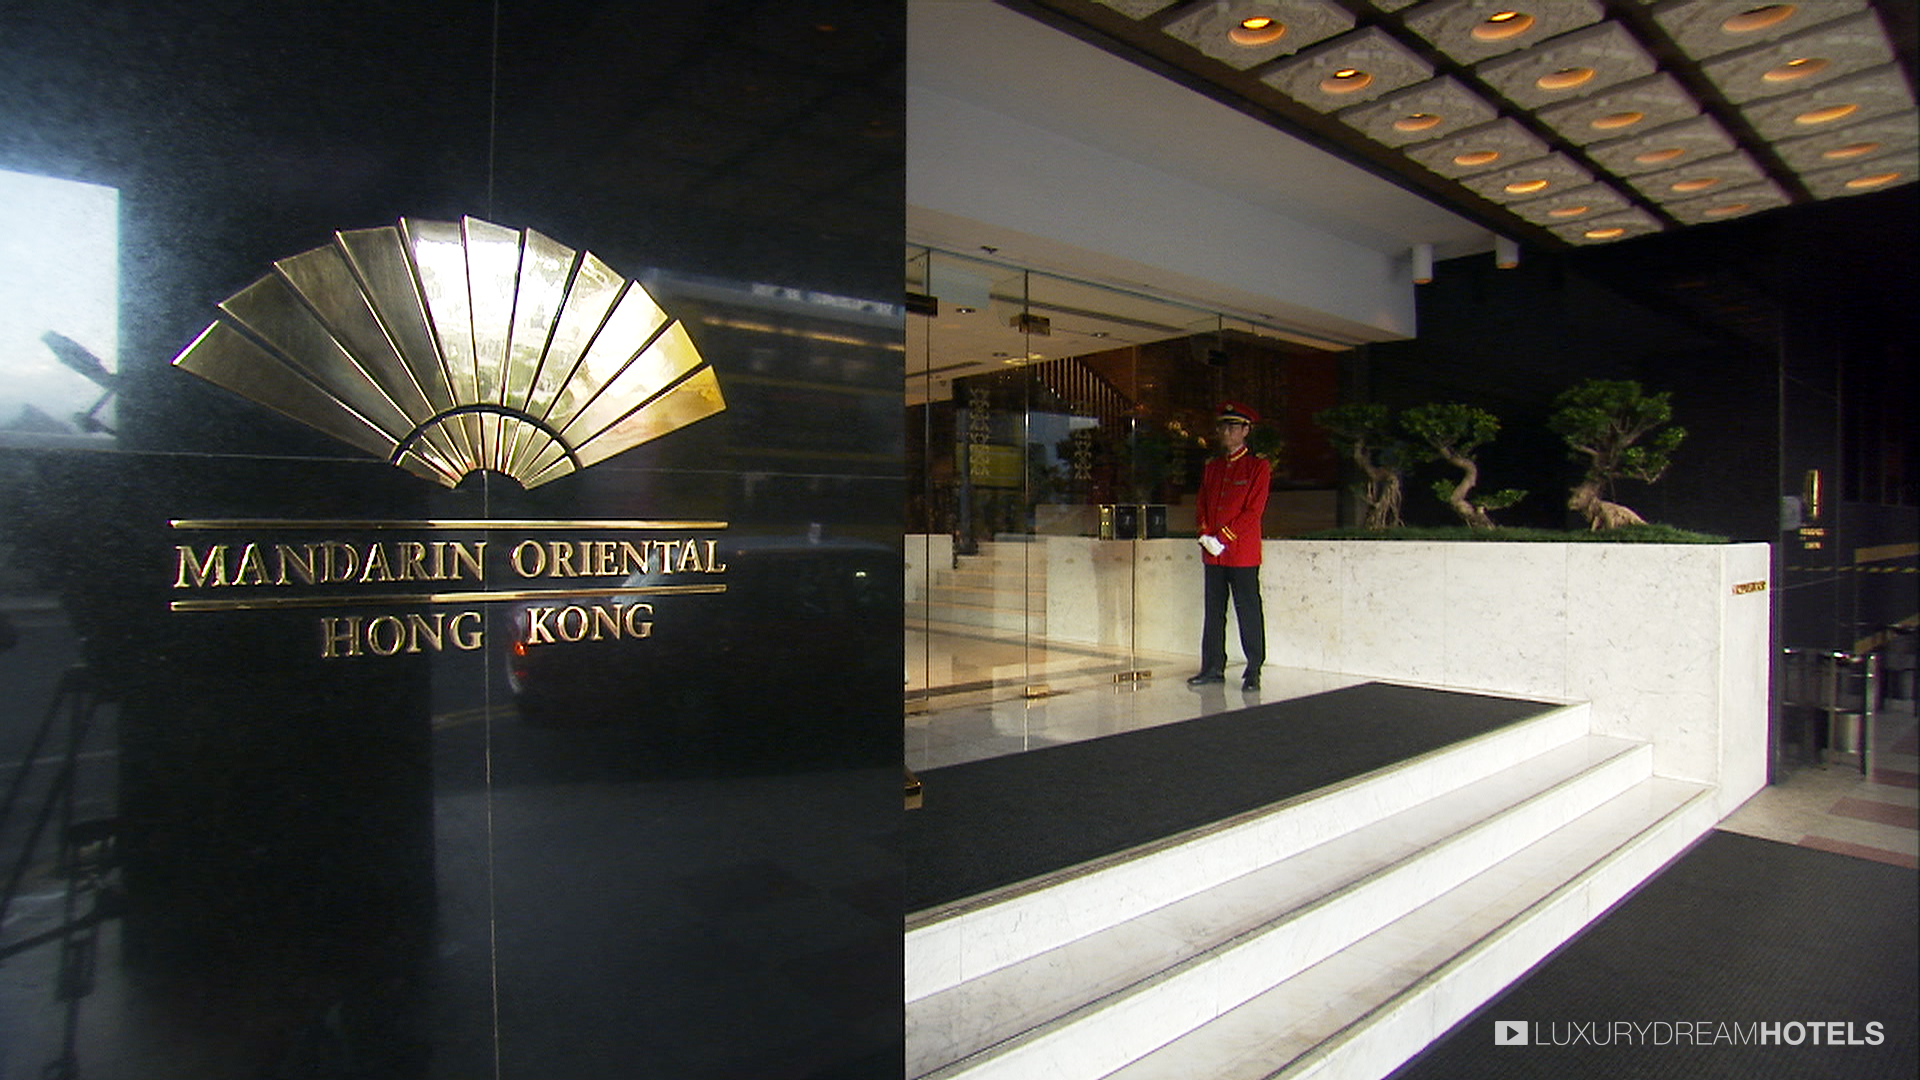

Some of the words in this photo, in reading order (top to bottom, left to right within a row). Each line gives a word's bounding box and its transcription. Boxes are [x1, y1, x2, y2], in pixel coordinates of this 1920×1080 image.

[173, 541, 487, 588] MANDARIN
[512, 539, 727, 578] ORIENTAL
[321, 612, 484, 658] HONG
[527, 603, 655, 645] KONG
